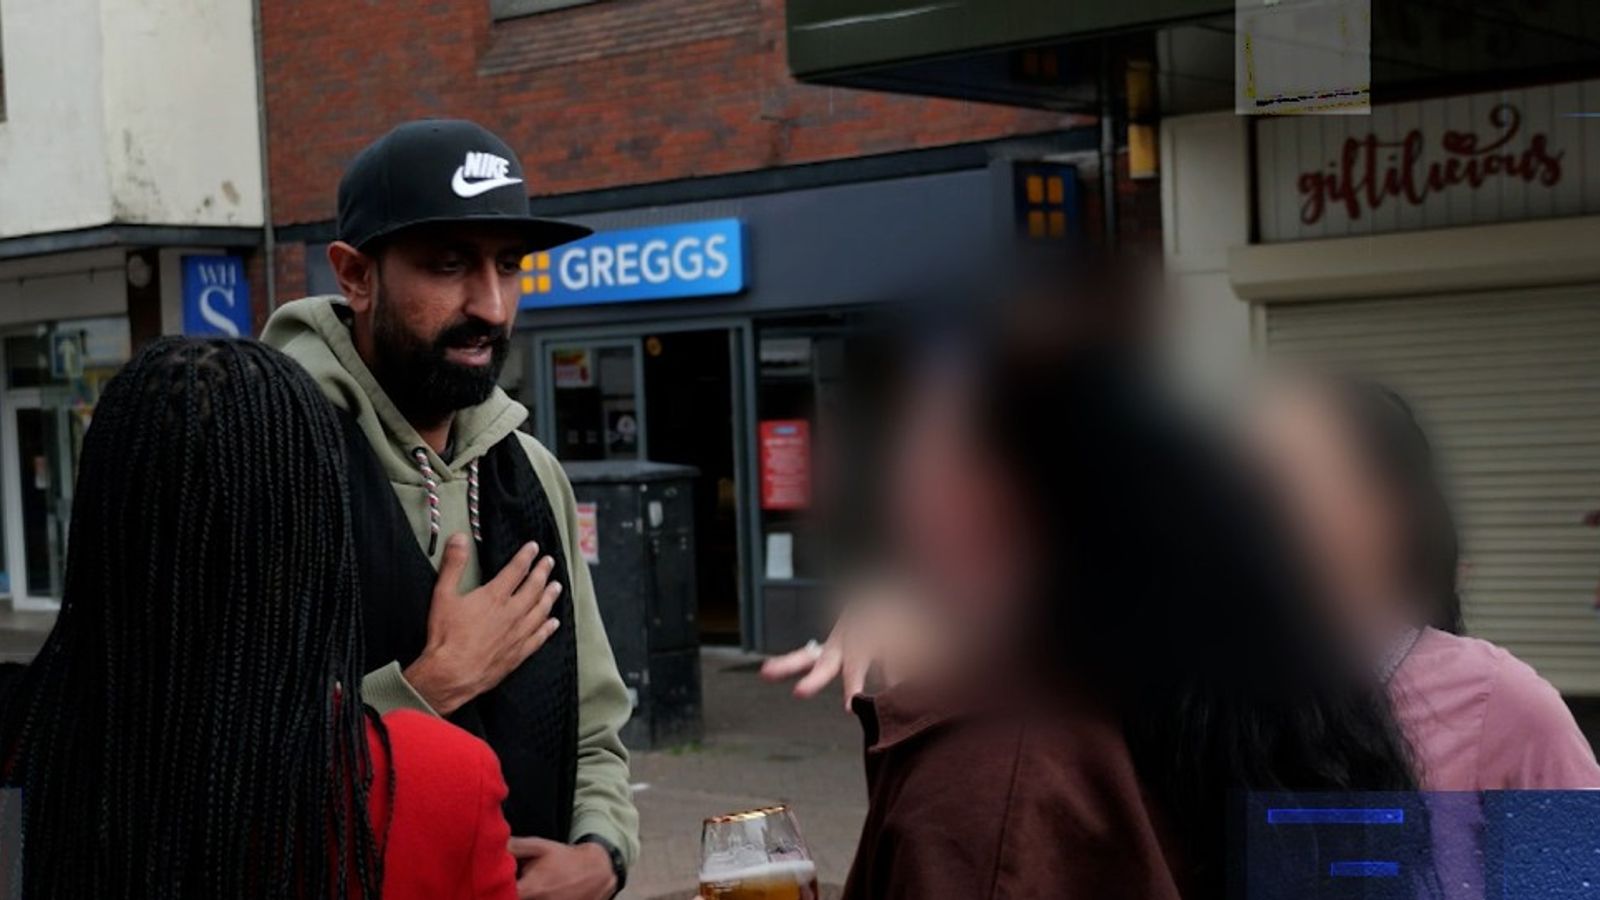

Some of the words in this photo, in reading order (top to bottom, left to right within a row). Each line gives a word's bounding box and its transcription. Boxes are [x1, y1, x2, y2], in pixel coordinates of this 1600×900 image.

[464, 150, 510, 179] NIKE
[198, 262, 236, 286] WH
[559, 234, 729, 291] GREGGS
